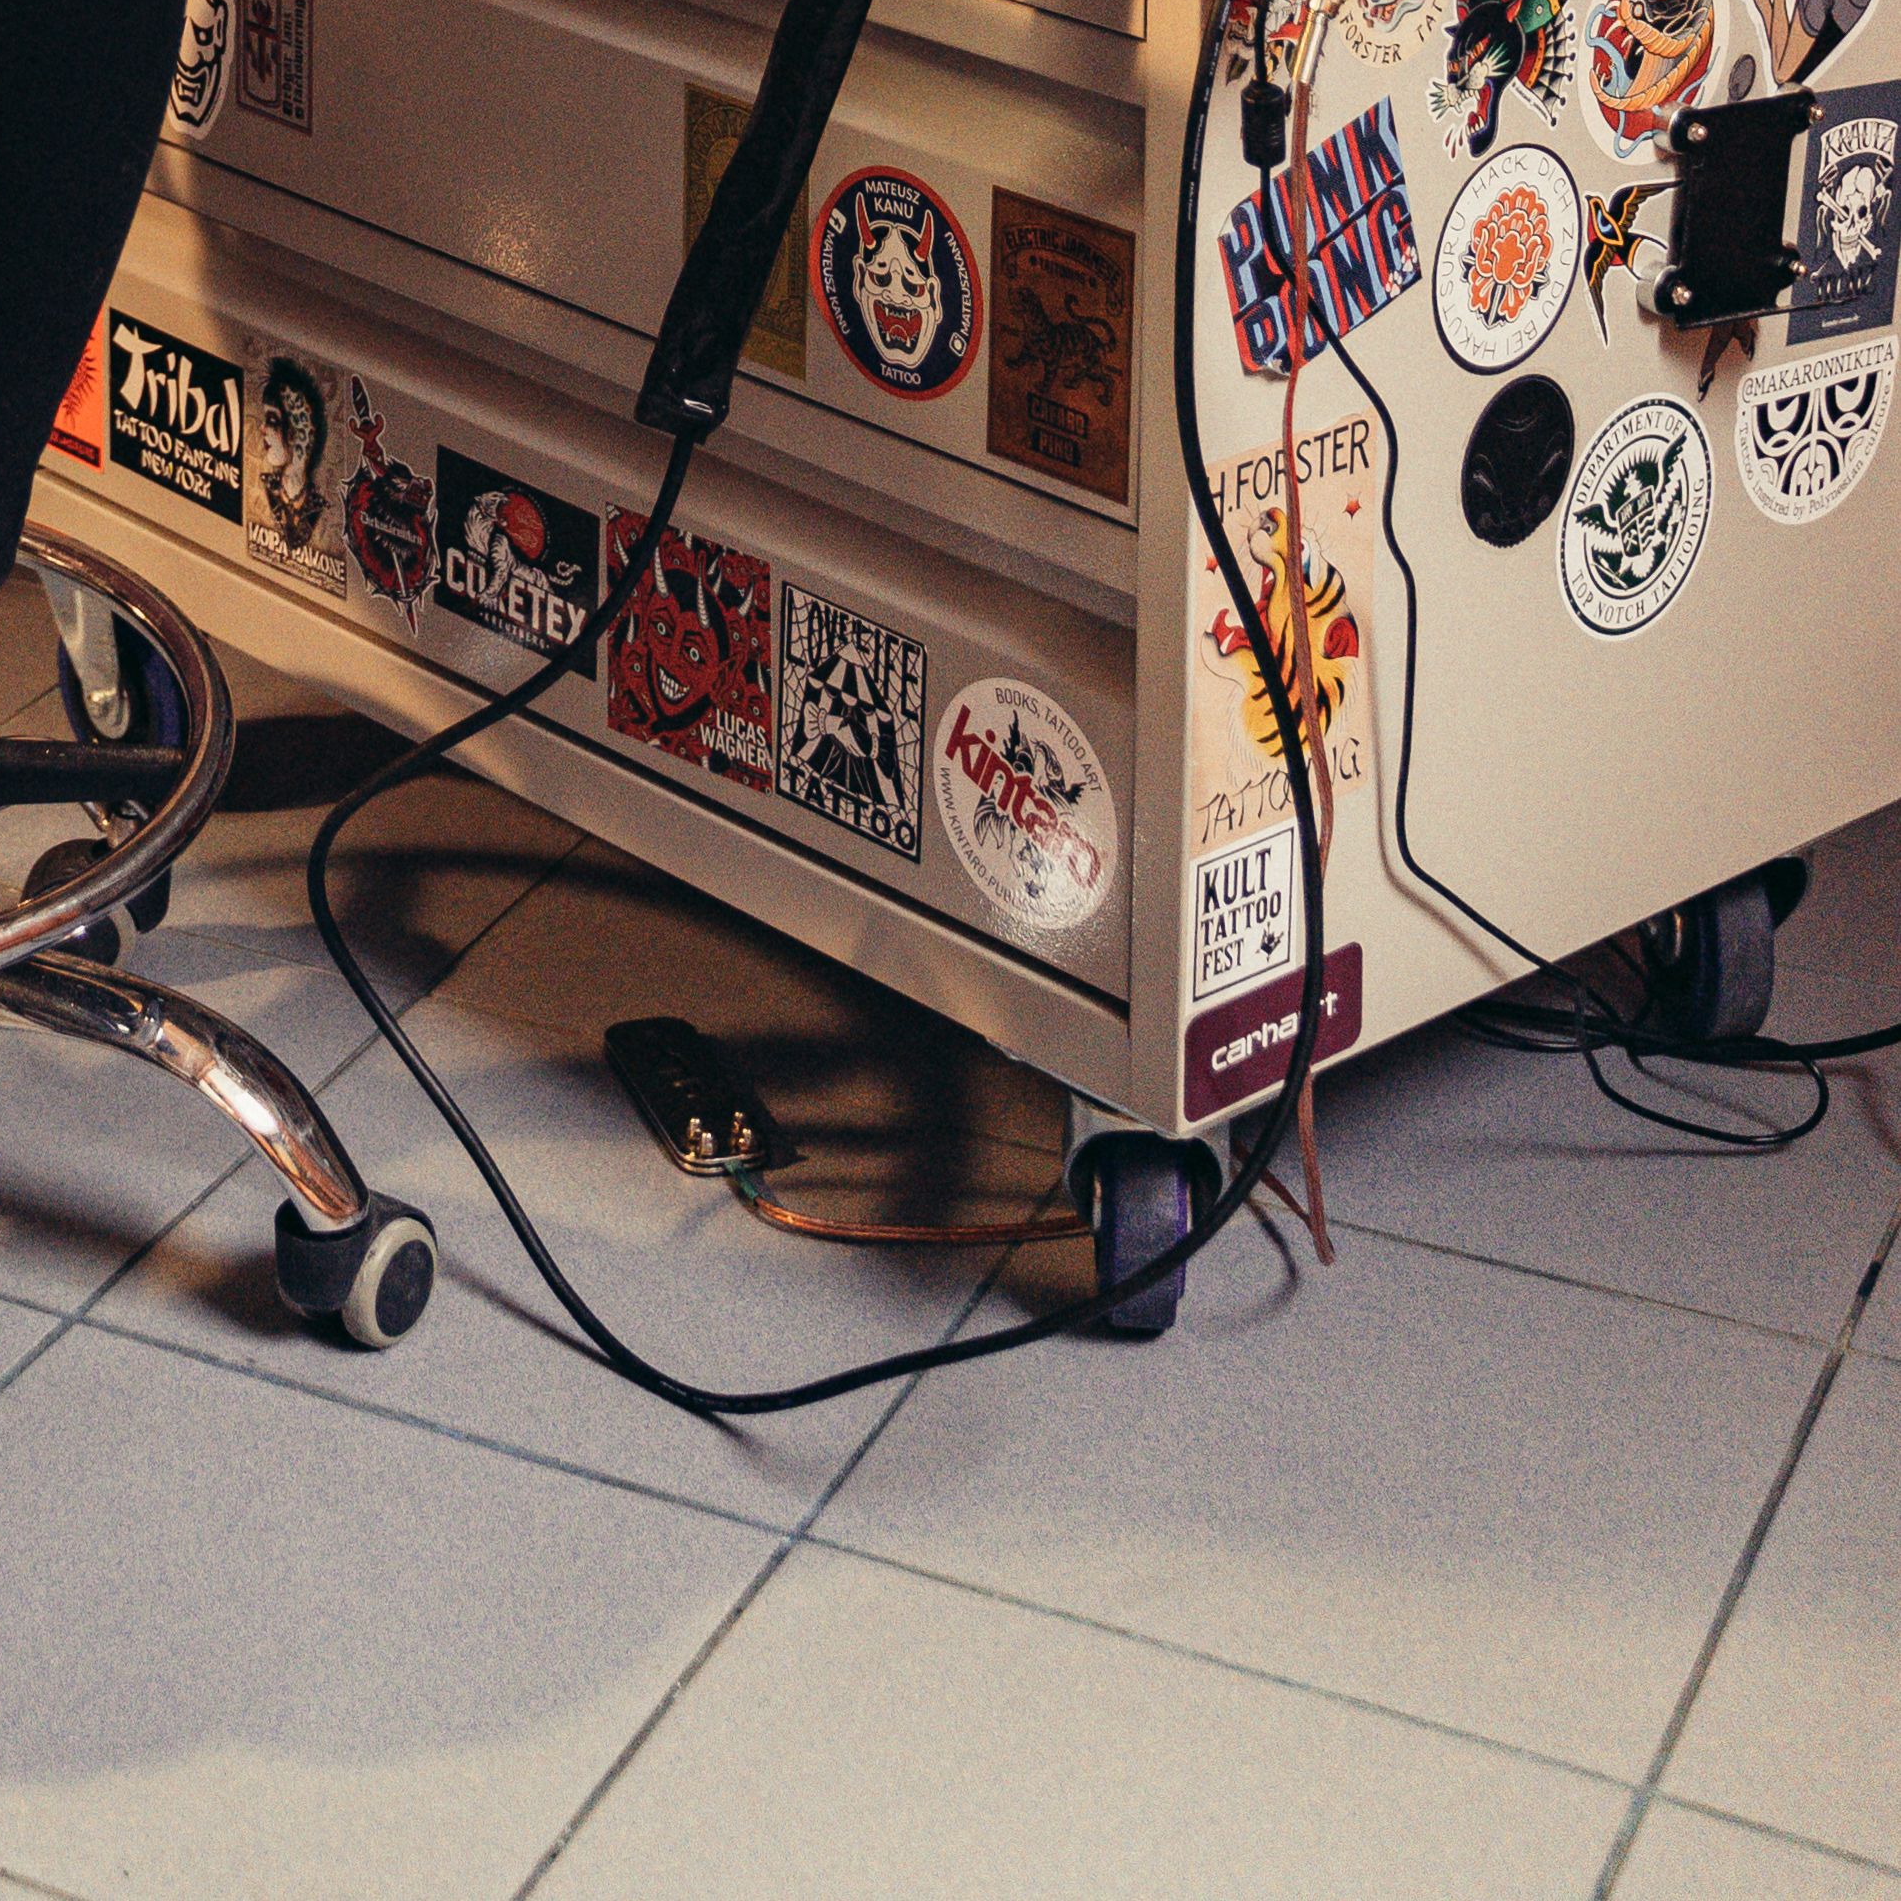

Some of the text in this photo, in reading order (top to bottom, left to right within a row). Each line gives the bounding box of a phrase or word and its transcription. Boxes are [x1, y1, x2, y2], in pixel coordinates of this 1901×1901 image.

[1340, 13, 1402, 64] FORSTER
[1824, 120, 1896, 165] KRAUTZ
[864, 179, 922, 206] MATEUSZ
[1471, 153, 1530, 200] HACK
[1538, 156, 1573, 214] DICH
[873, 197, 915, 219] KANU
[1217, 95, 1405, 316] PUNK
[1559, 226, 1575, 267] ZU
[822, 230, 851, 336] MATEUSZ KANU
[1541, 279, 1565, 319] DU
[1506, 319, 1539, 356] BEI
[112, 323, 241, 458] Tribal
[879, 362, 923, 386] TATTOO
[1742, 342, 1895, 404] @MAKARONNIKITA
[113, 408, 173, 455] TATTOO
[174, 437, 240, 490] FANZINE
[141, 449, 174, 480] NEW
[1575, 410, 1663, 506] DEPARTMENT
[1665, 413, 1684, 437] OF
[1571, 477, 1706, 624] TOP NOTCH TATTOOING
[786, 589, 849, 670] LOVE
[699, 722, 769, 772] WAGNER
[716, 708, 767, 747] LUCAS
[994, 687, 1103, 794] BOOKS, TATTOO ART
[782, 759, 916, 851] TATTOO
[1201, 847, 1273, 915] KULT
[1201, 890, 1282, 946] TATTOO
[1201, 939, 1245, 982] FEST
[1211, 991, 1339, 1072] carhat
